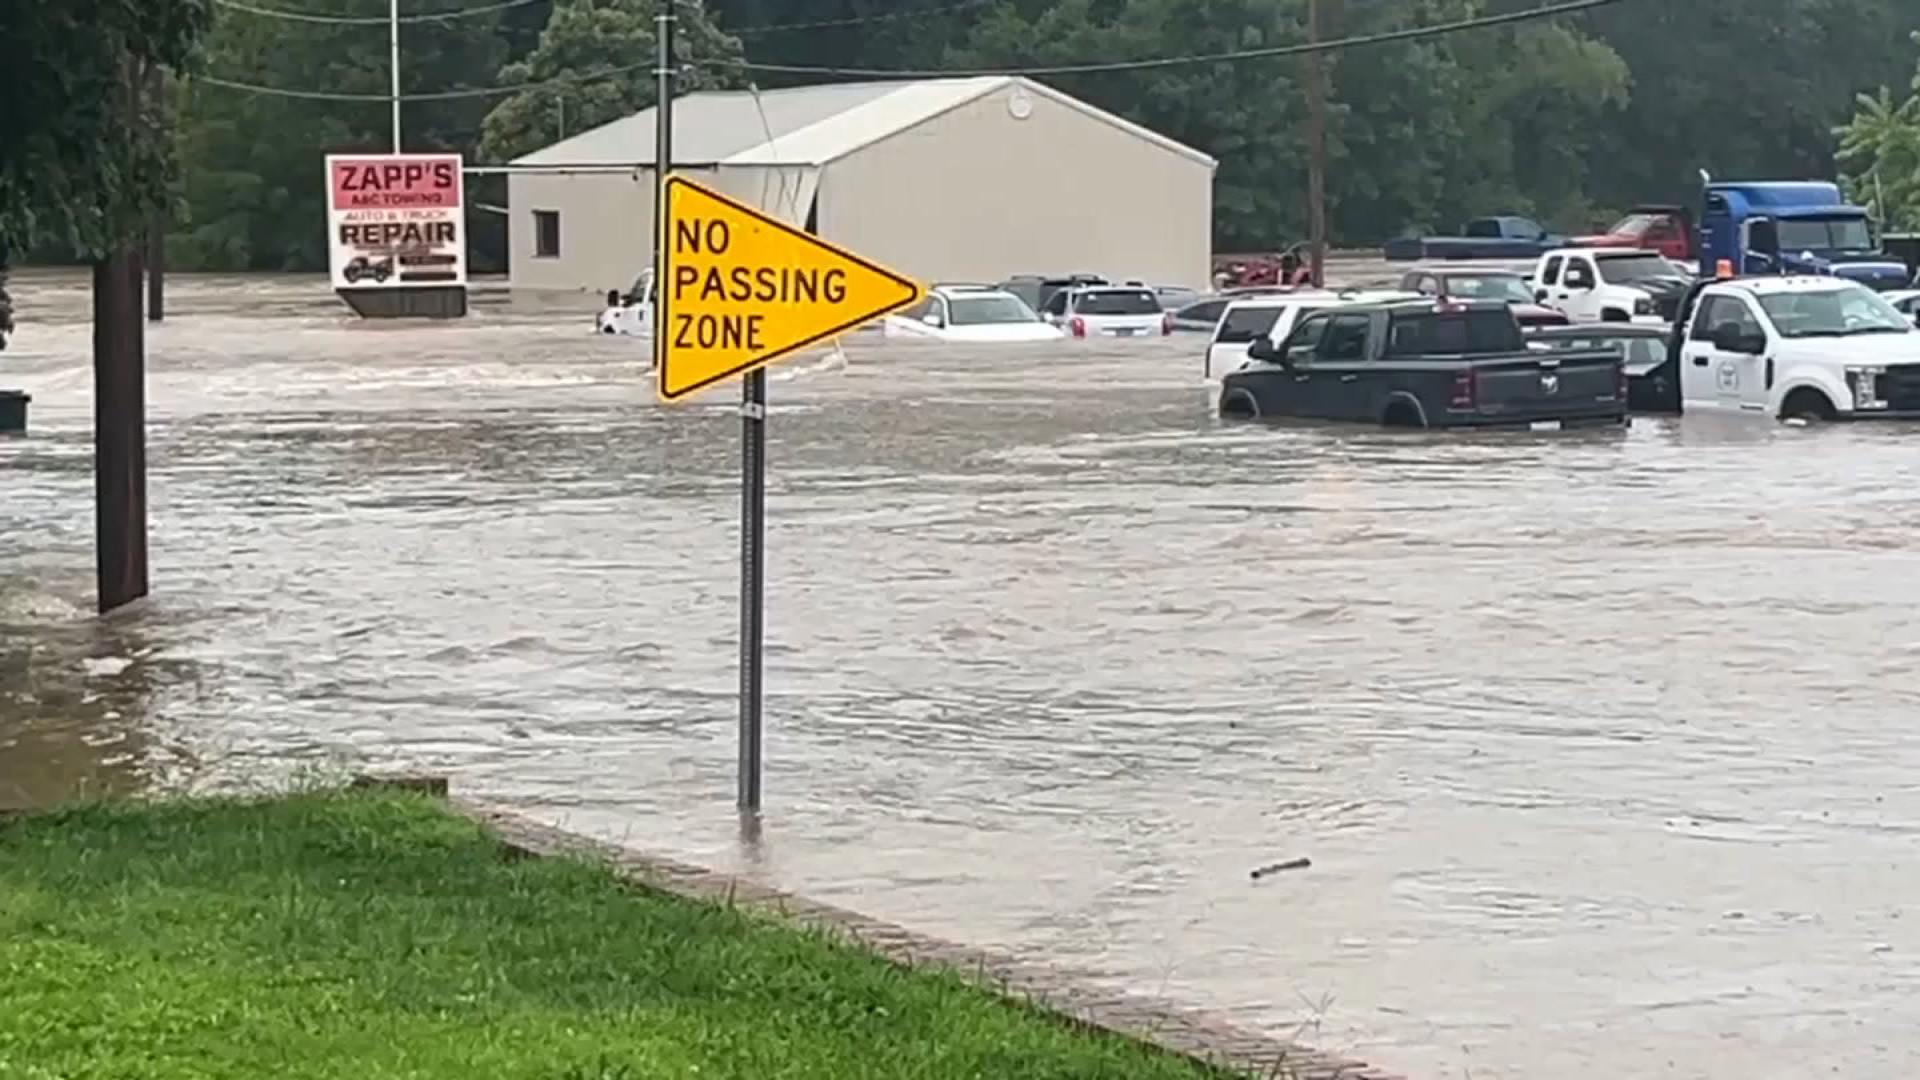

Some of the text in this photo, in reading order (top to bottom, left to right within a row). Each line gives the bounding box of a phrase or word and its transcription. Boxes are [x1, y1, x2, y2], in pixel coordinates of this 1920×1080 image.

[340, 163, 452, 191] ZAPP'S
[339, 222, 455, 244] REPAIR
[676, 218, 730, 254] NO
[675, 266, 847, 303] PASSING
[674, 314, 765, 349] ZONE
